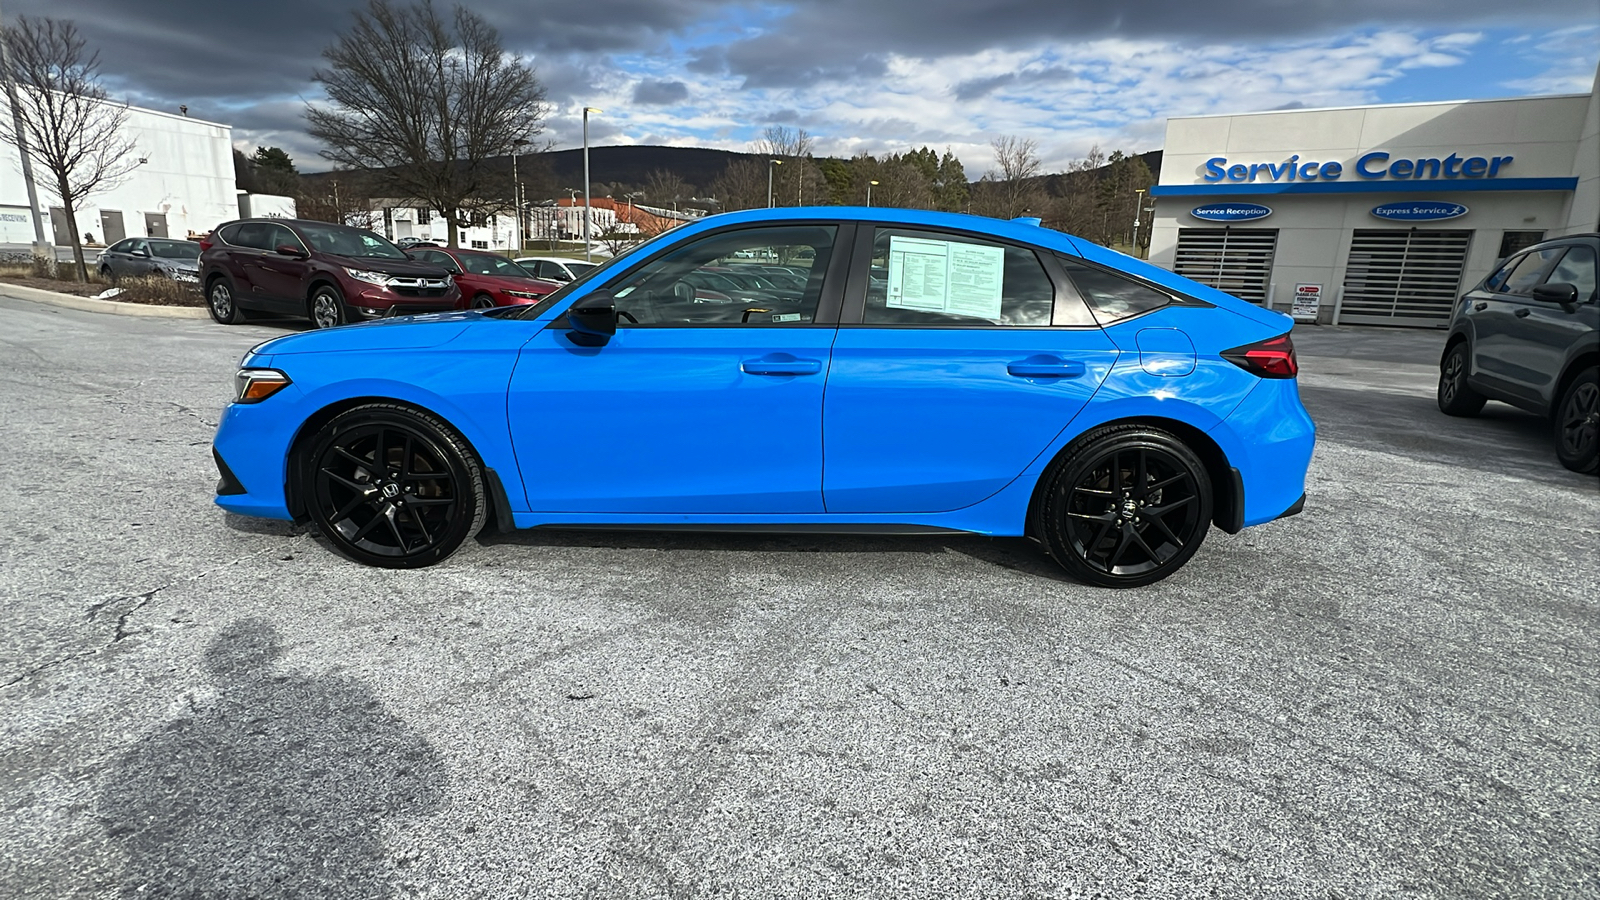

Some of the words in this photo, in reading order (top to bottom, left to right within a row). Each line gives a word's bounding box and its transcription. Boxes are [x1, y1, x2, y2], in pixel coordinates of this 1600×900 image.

[1204, 154, 1343, 181] Service
[1356, 151, 1514, 179] Center
[1196, 207, 1225, 215] Service
[1226, 207, 1266, 216] Reception
[1376, 207, 1410, 216] Express
